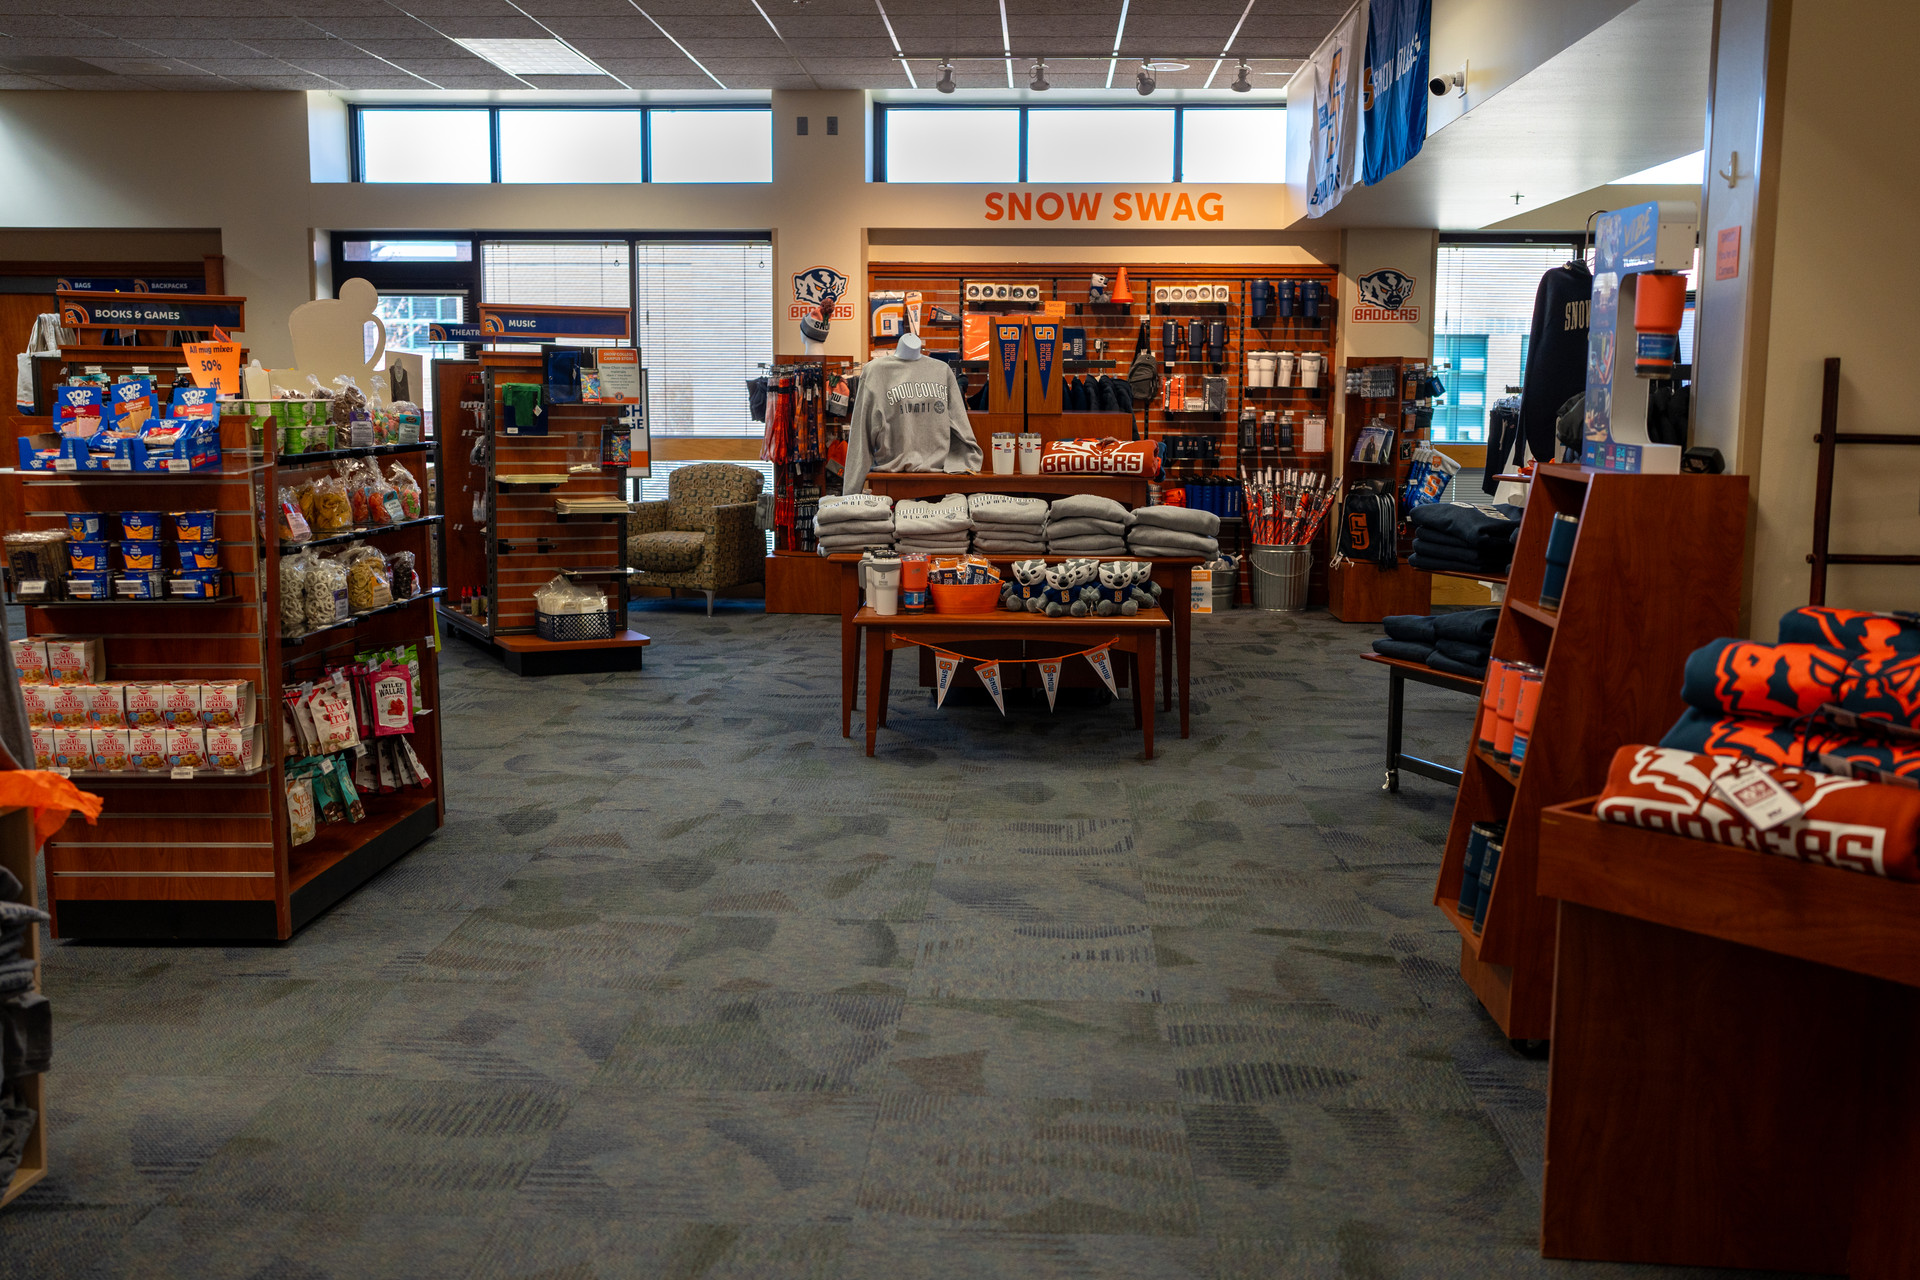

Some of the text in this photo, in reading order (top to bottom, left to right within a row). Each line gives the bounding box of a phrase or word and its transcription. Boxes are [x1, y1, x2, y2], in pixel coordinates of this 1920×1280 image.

[984, 192, 1225, 221] SNOW SWAG
[151, 282, 188, 290] BACKPACKS
[95, 309, 180, 320] BOOKS & GAMES
[1353, 308, 1419, 322] BADGERS
[508, 319, 537, 328] MUSIC
[450, 328, 480, 336] THEATR
[198, 348, 212, 356] mug
[201, 360, 222, 372] 50%
[887, 382, 914, 406] SNOW
[1042, 453, 1142, 473] BADGERS
[1099, 662, 1111, 680] SNOW
[939, 670, 948, 690] SNOW
[988, 677, 999, 696] SNOW
